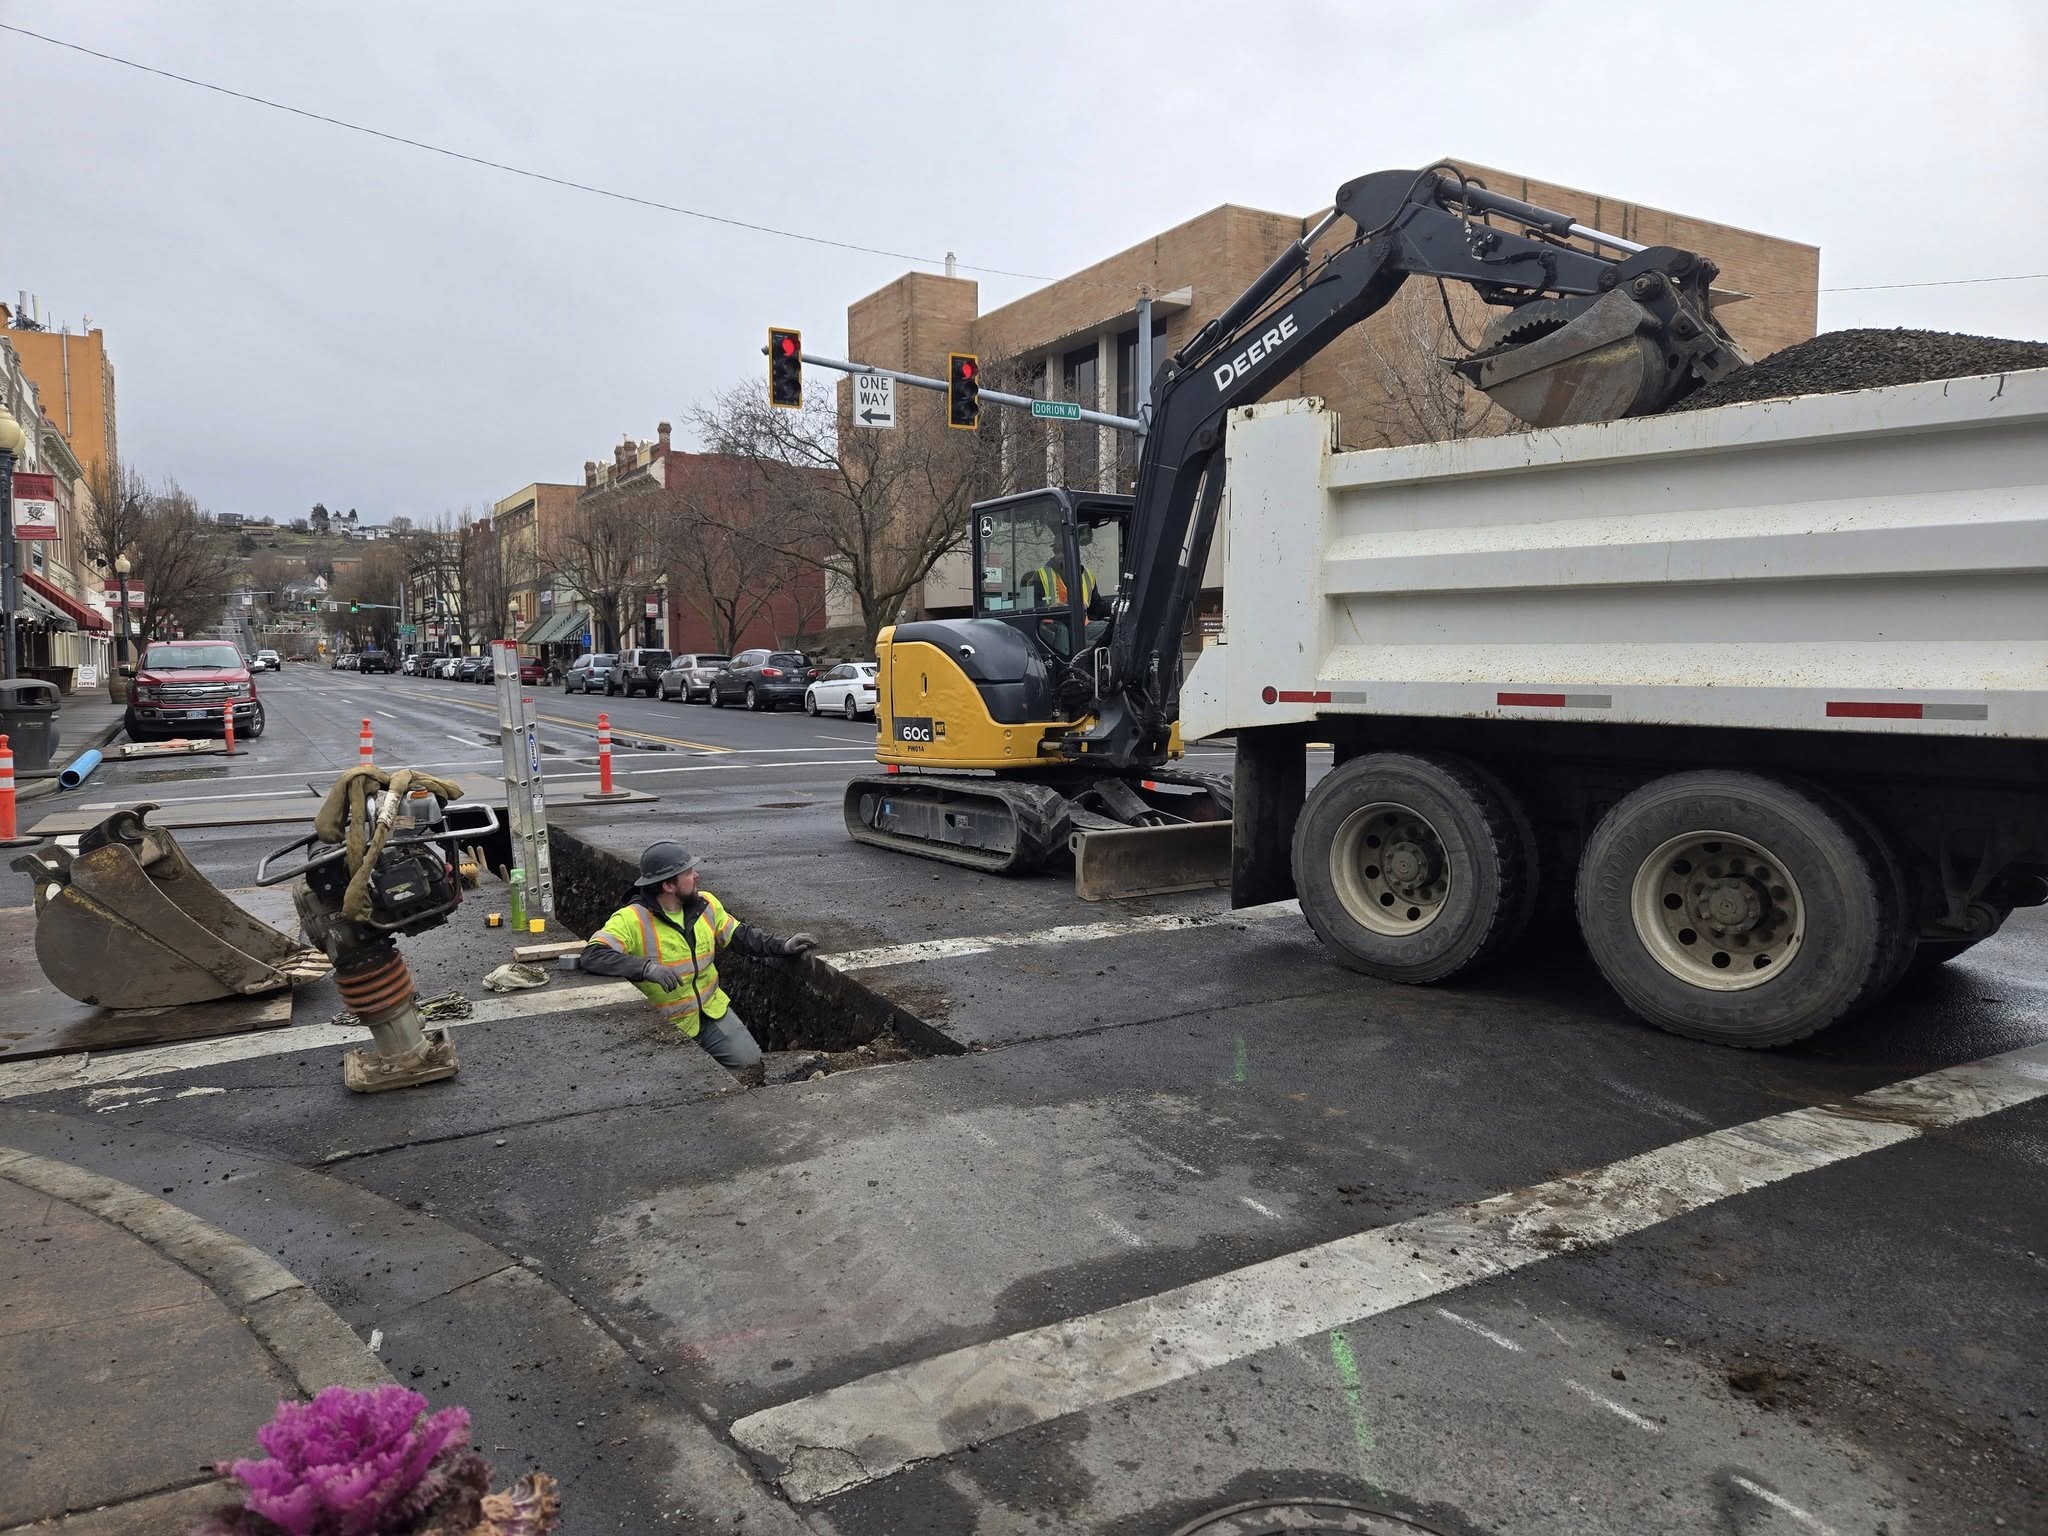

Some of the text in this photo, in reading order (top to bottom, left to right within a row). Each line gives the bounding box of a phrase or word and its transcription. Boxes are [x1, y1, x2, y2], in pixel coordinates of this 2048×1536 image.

[1213, 313, 1298, 392] DEERE
[860, 376, 889, 390] ONE
[860, 392, 889, 406] WAY
[1035, 403, 1077, 416] DORION AV
[903, 726, 930, 741] 60G
